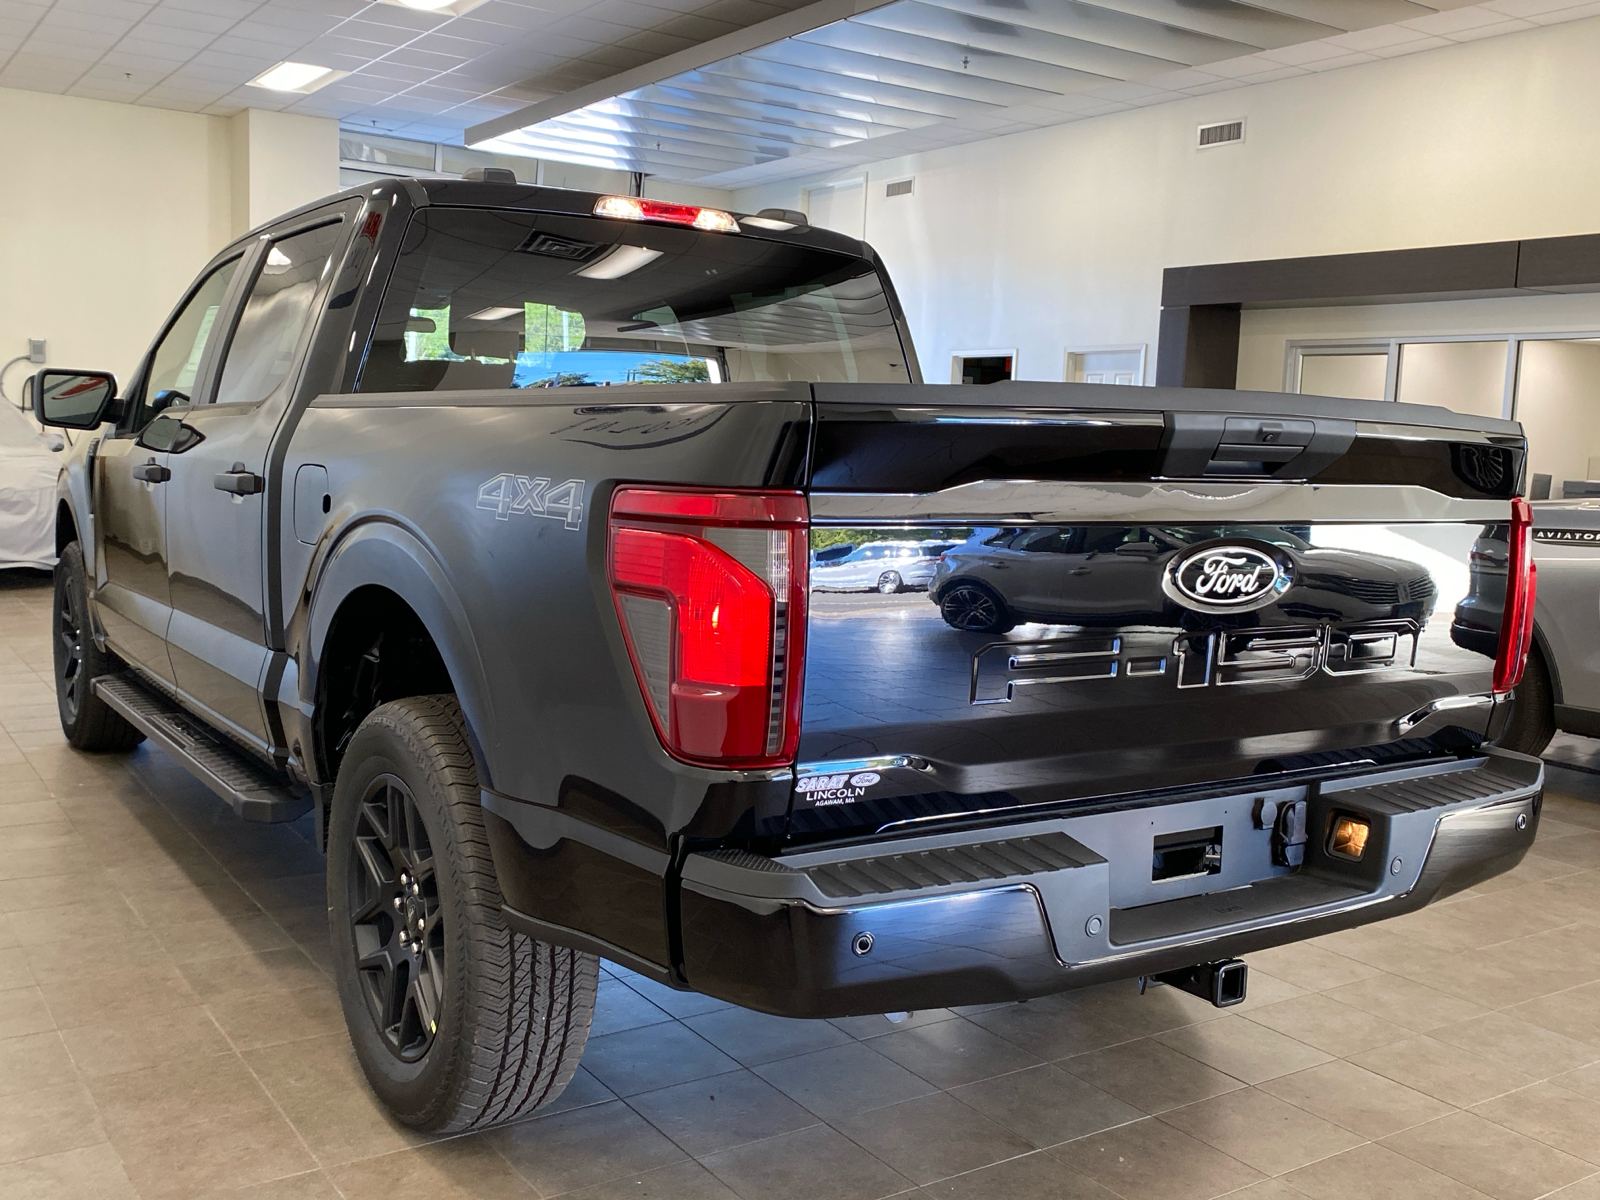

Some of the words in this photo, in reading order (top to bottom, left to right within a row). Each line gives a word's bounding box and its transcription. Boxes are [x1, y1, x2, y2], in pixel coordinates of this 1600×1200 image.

[1196, 555, 1262, 593] Ford
[969, 617, 1419, 705] F-150
[795, 774, 849, 792] SARAT
[806, 787, 865, 801] LINCOLN
[815, 798, 844, 807] AGAWAM,
